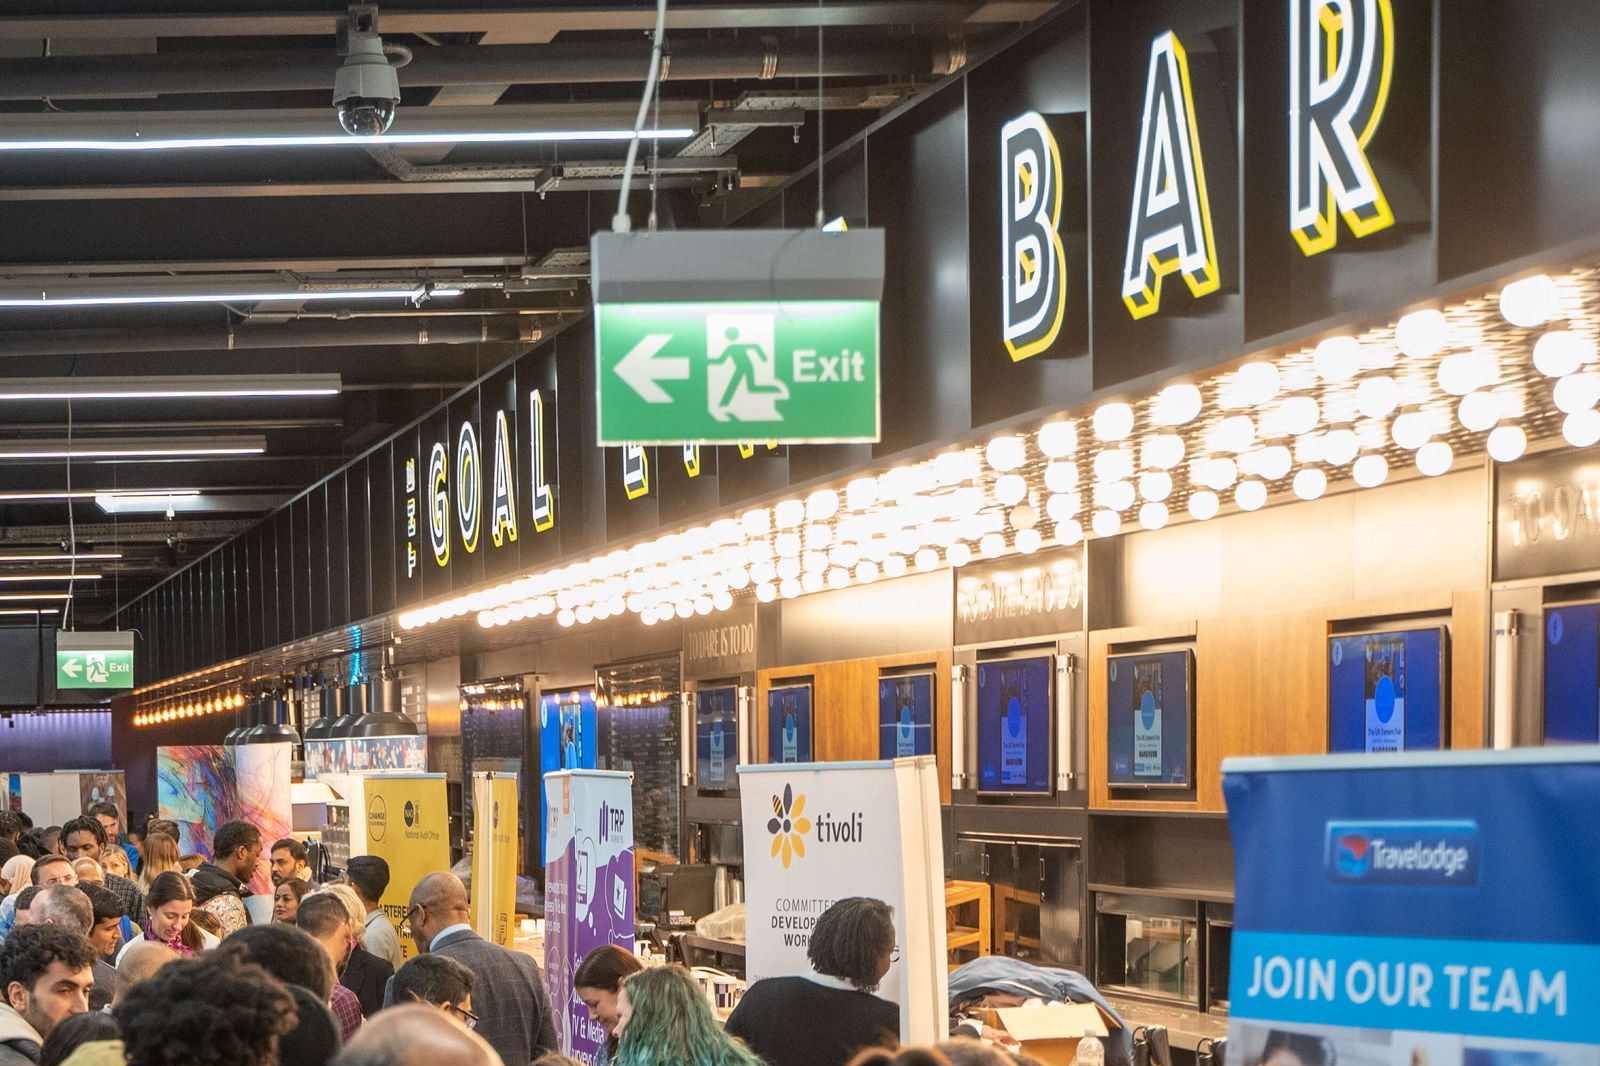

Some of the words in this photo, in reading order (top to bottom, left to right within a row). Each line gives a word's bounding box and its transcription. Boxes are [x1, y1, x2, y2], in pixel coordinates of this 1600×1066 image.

[1001, 0, 1395, 362] BAR
[793, 348, 865, 382] Exit
[428, 389, 554, 567] GOAL
[689, 632, 698, 660] TO
[700, 629, 720, 658] DARE
[721, 627, 728, 656] IS
[729, 625, 740, 654] TO
[741, 623, 753, 653] DO
[109, 662, 129, 672] Exit
[369, 812, 385, 820] CHANGE
[610, 808, 624, 832] TRP
[816, 812, 863, 843] tivoli
[1370, 840, 1468, 876] Travelodge
[1247, 955, 1336, 1002] JOIN
[1345, 960, 1434, 1008] OUR
[1443, 966, 1567, 1016] TEAM
[572, 1014, 580, 1037] TV
[580, 1016, 586, 1039] &
[587, 1018, 604, 1044] Media
